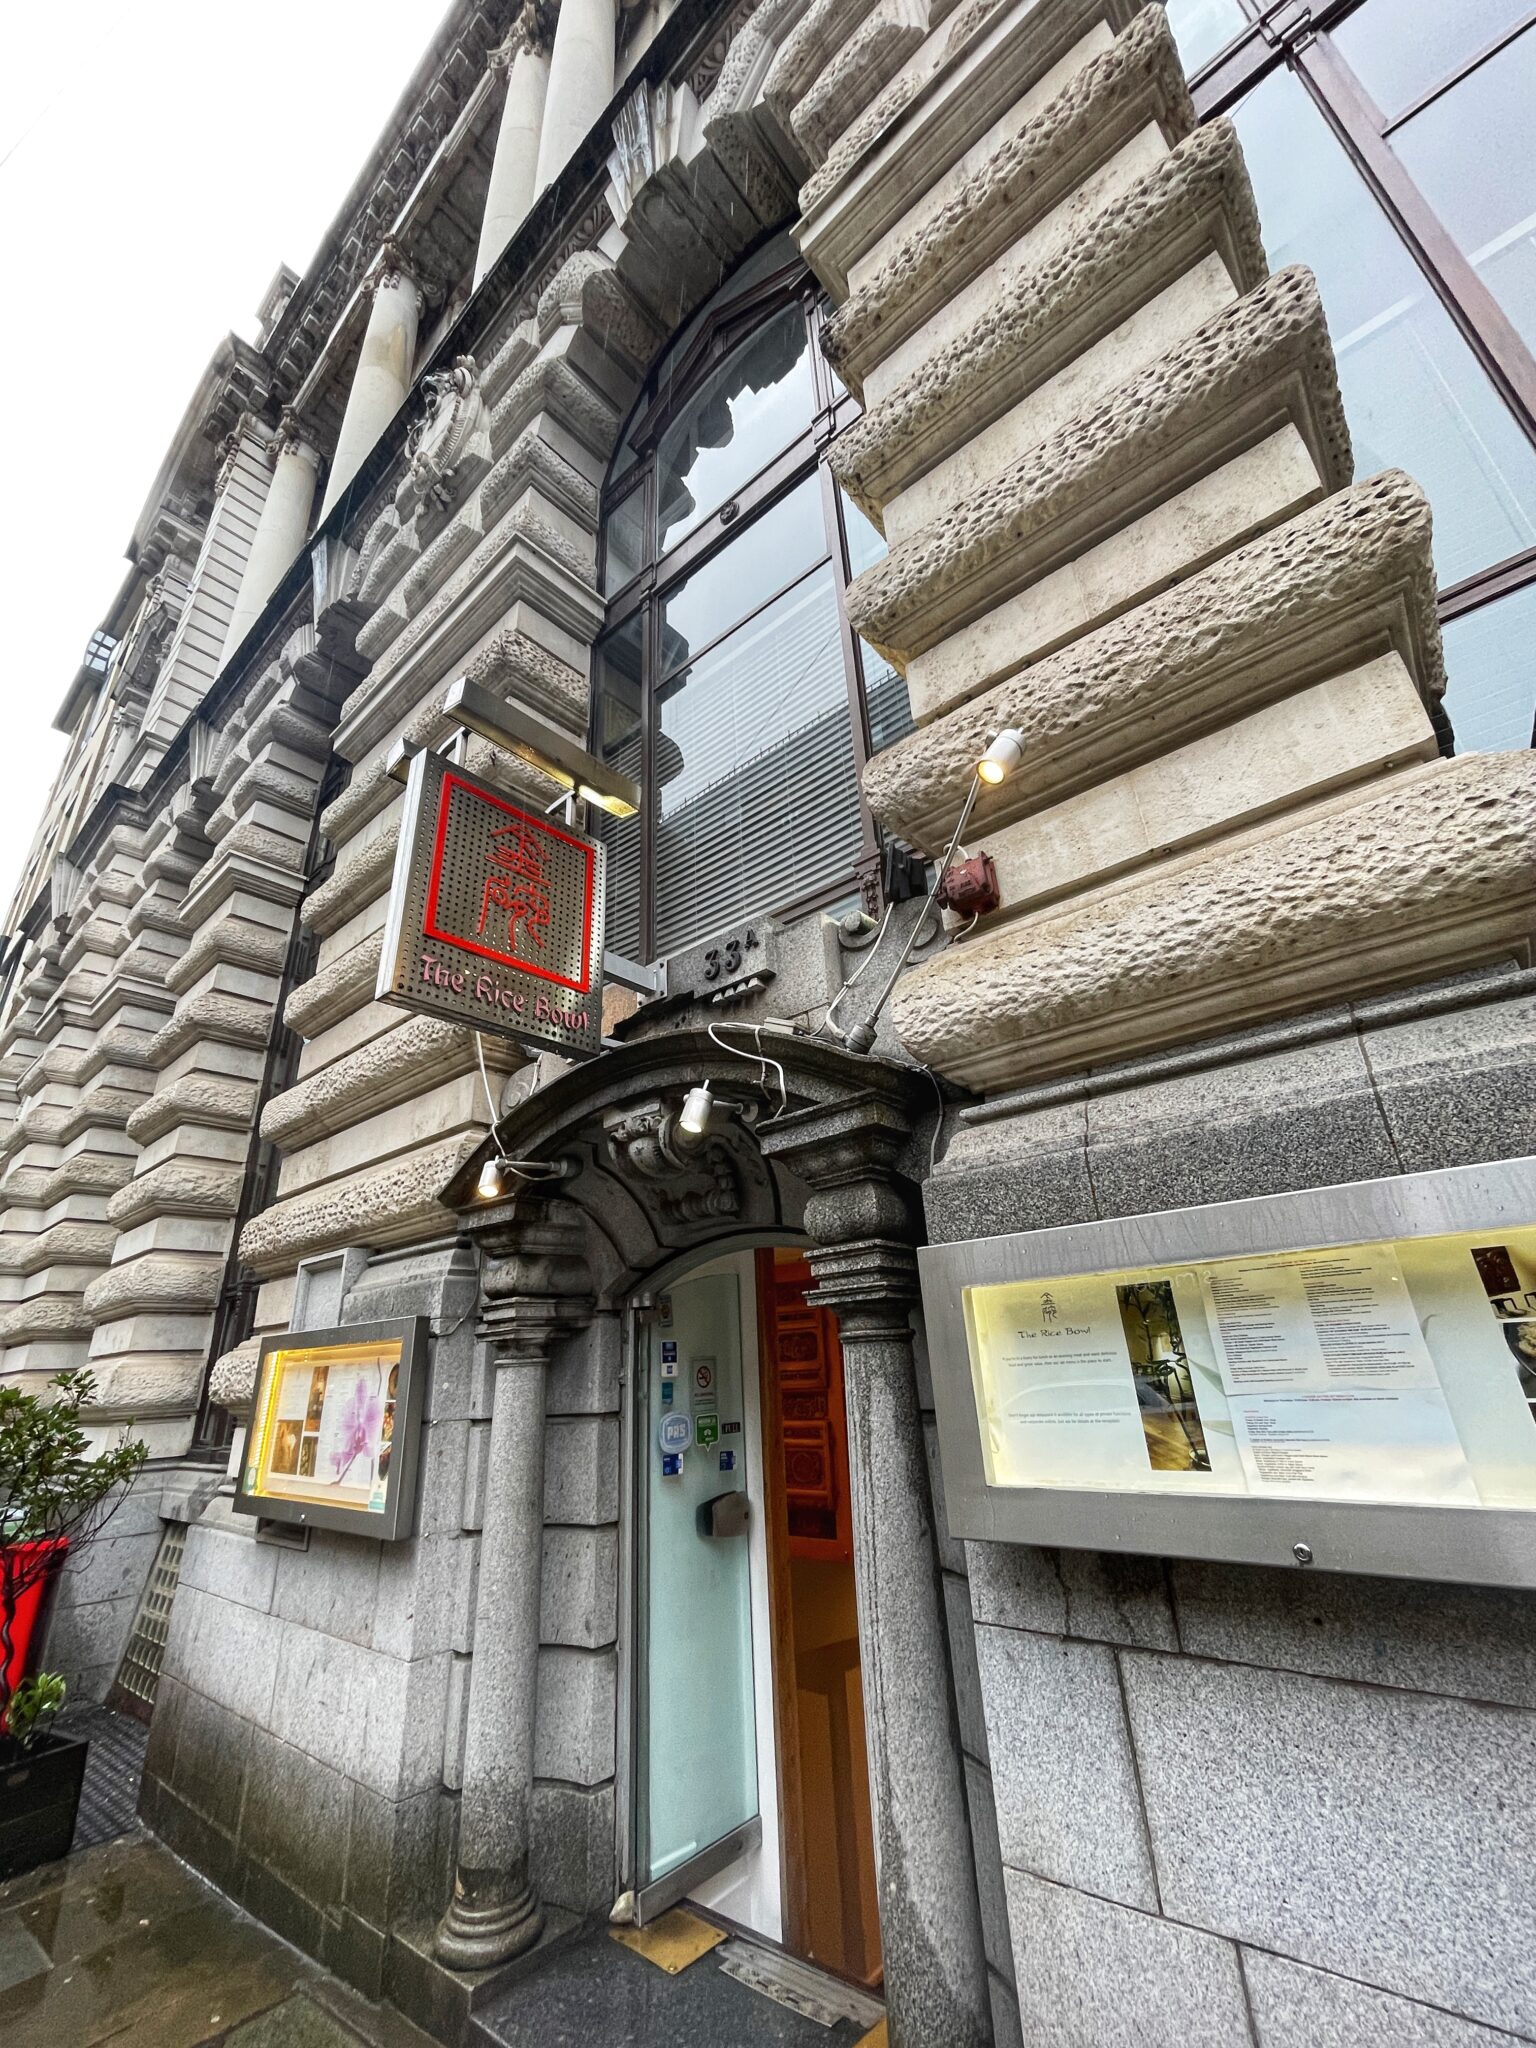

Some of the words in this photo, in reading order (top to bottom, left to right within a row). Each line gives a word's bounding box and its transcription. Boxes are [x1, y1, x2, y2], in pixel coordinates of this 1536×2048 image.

[420, 954, 464, 993] The
[475, 975, 525, 1013] Rice
[534, 996, 590, 1032] Bowl
[1017, 1330, 1037, 1339] The
[1040, 1329, 1061, 1337] Rice
[1065, 1326, 1091, 1336] Bowl
